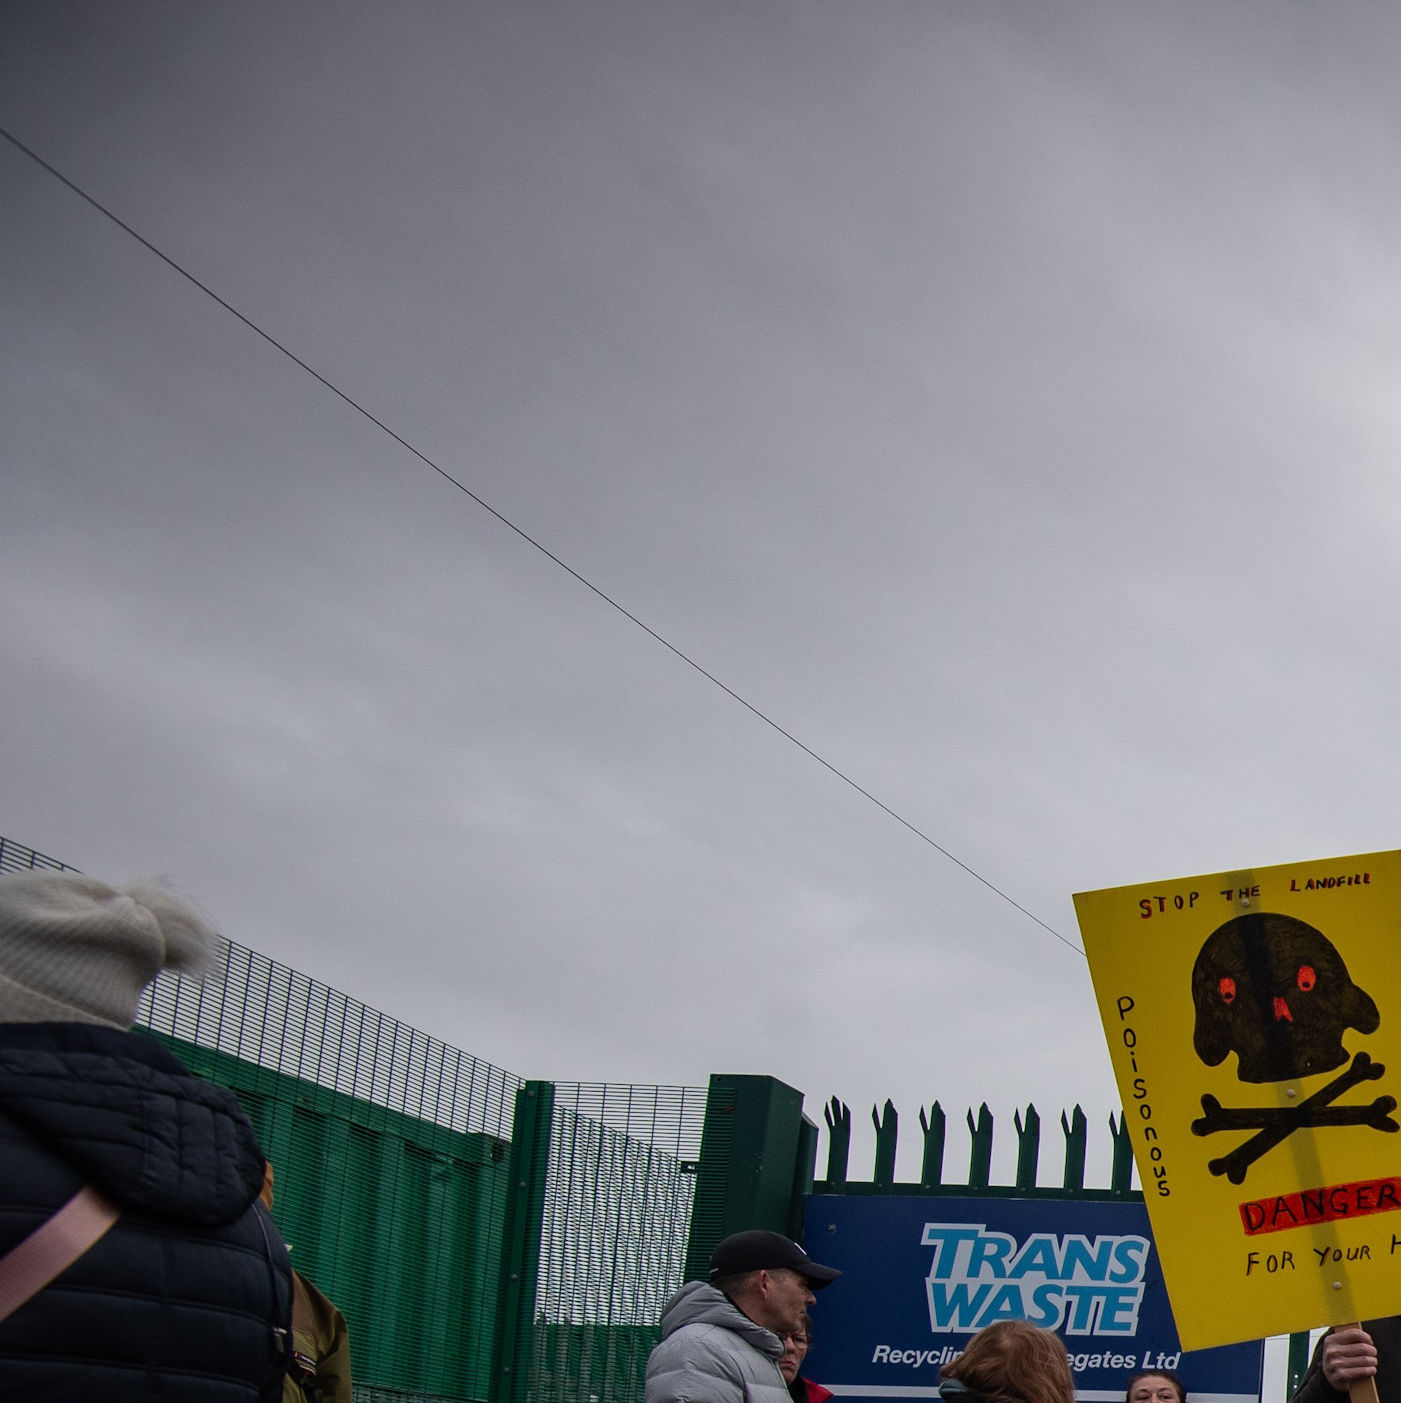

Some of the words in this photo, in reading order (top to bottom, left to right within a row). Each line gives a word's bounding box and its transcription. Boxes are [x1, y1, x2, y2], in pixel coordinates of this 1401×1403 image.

[1139, 891, 1200, 919] STOP
[1220, 885, 1261, 900] THE
[1289, 872, 1372, 893] LANDFILL
[1246, 1182, 1401, 1232] DANGER
[922, 1223, 1150, 1283] TRANS
[1246, 1251, 1296, 1276] FOR
[1313, 1244, 1372, 1268] YOUR
[926, 1278, 1145, 1335] WASTE
[1142, 1351, 1181, 1370] Ltd
